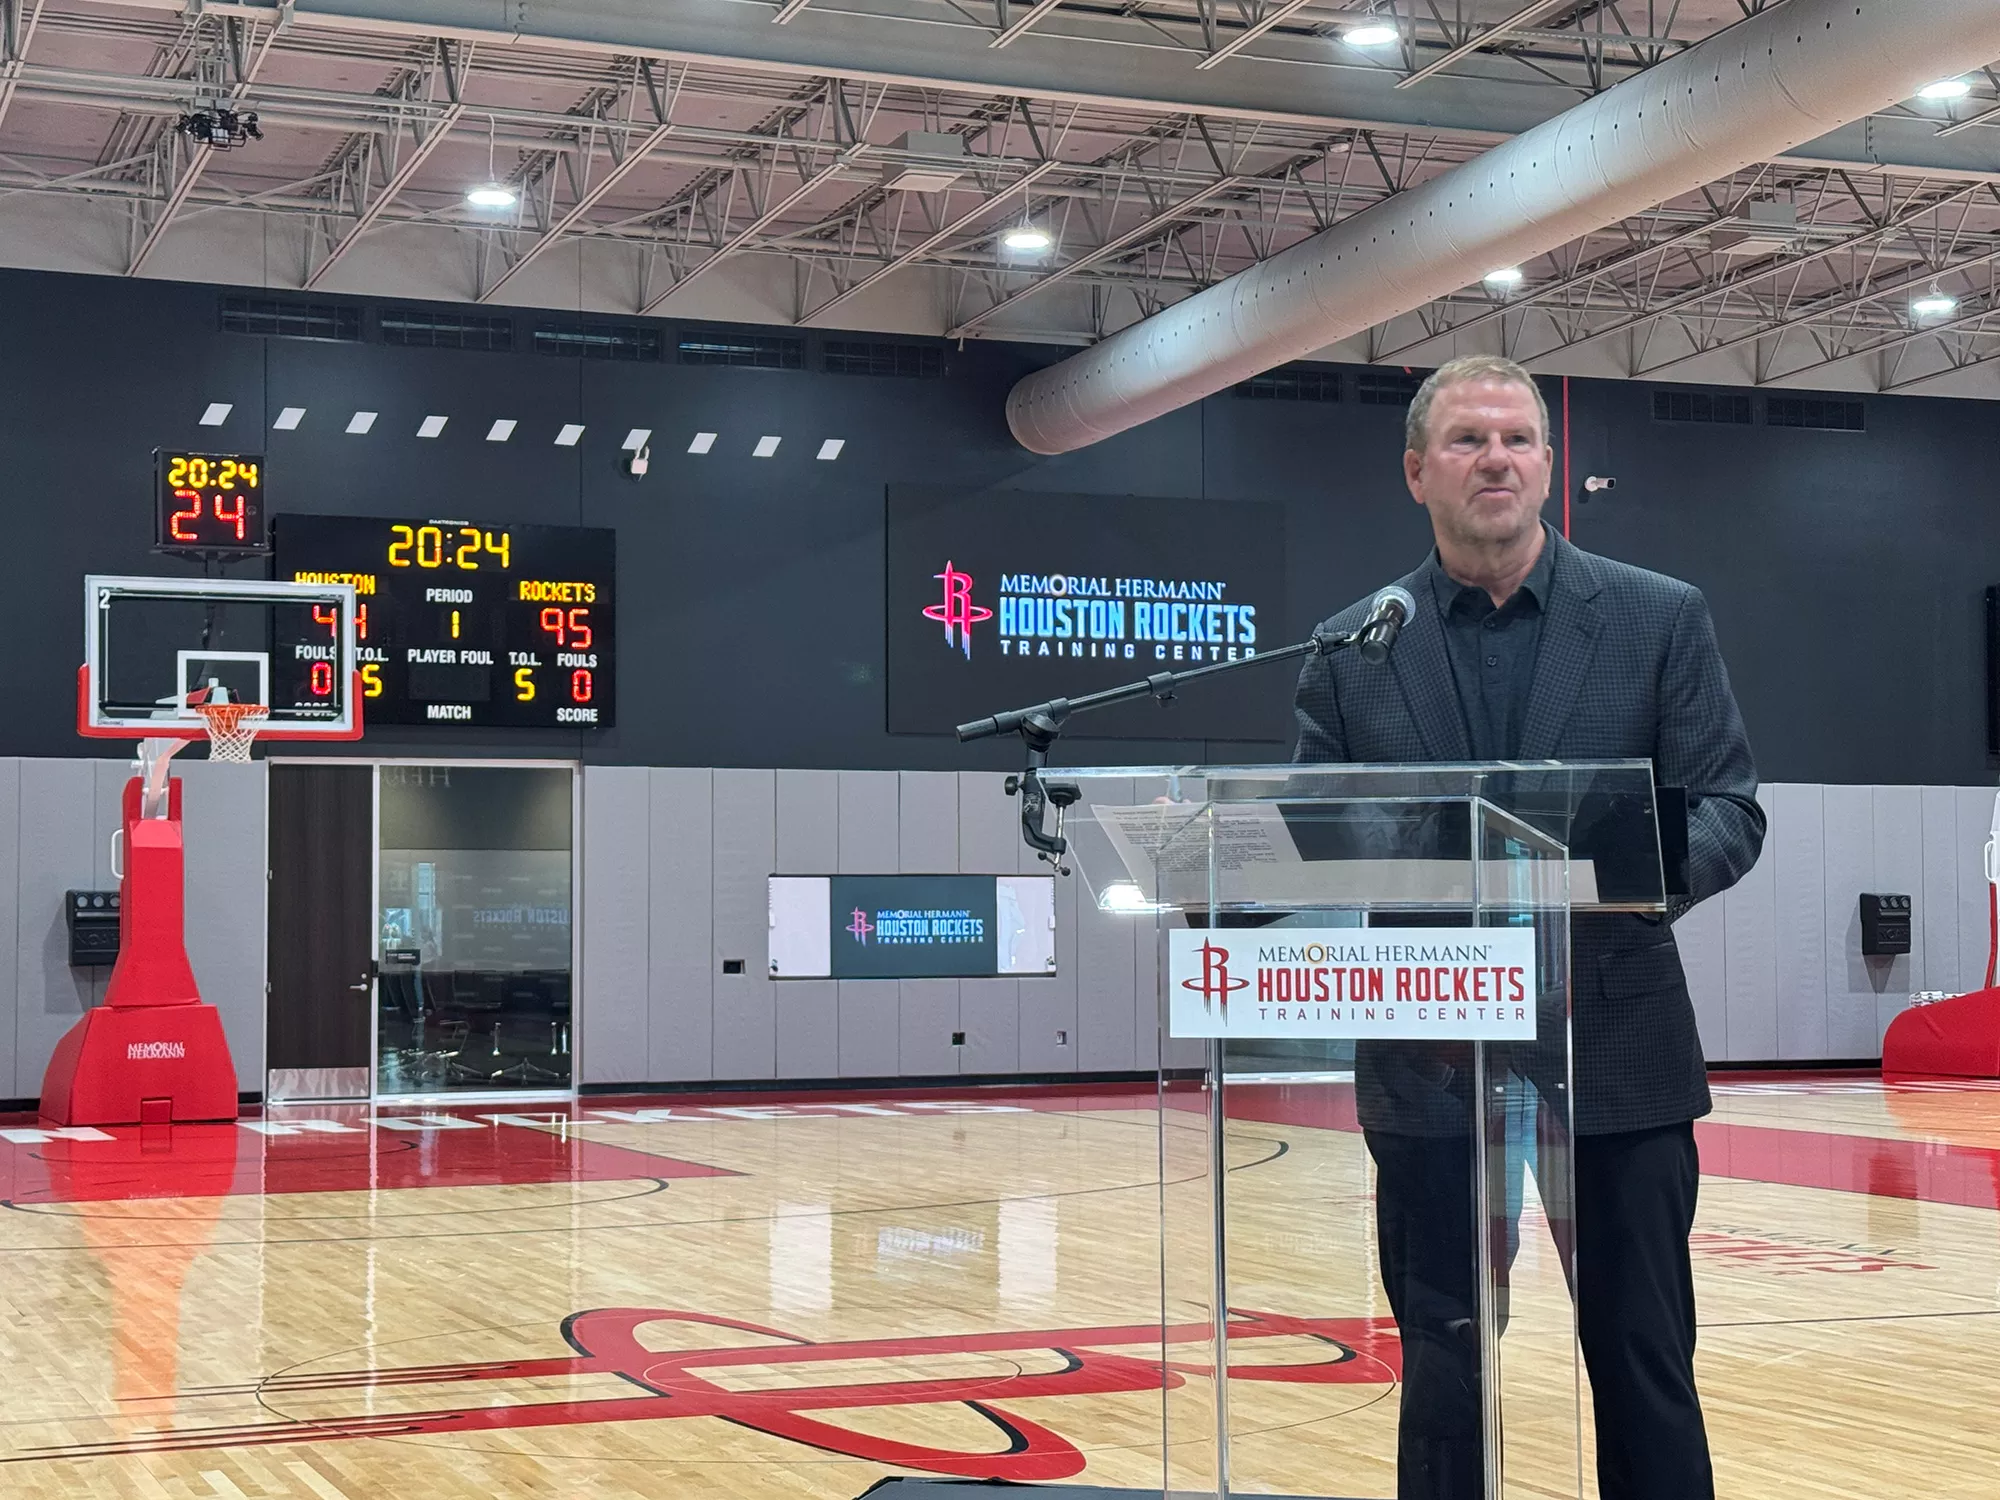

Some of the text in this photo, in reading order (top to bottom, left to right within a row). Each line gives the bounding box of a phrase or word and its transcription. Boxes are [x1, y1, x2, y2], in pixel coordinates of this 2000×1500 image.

[168, 457, 258, 490] 20:24
[170, 489, 245, 541] 24
[388, 525, 510, 570] 20:24
[426, 588, 473, 603] PERIOD
[519, 580, 596, 603] ROCKETS
[1000, 573, 1111, 597] MEMORIAL
[99, 588, 111, 610] 2
[452, 610, 460, 639] 1
[540, 607, 592, 649] 95
[1000, 597, 1256, 644] HOUSTON ROCKETS
[295, 645, 336, 660] FOULS
[408, 649, 494, 665] PLAYER FOUL
[509, 652, 542, 666] T.O.L.
[1001, 640, 1135, 658] TRAINING
[557, 653, 597, 667] FOULS
[311, 662, 332, 695] 0
[361, 664, 383, 697] 5
[514, 668, 535, 701] 5
[571, 669, 592, 702] 0
[427, 705, 471, 720] MATCH
[556, 708, 598, 722] SCORE
[877, 909, 923, 919] MEMORIAL
[876, 919, 984, 937] HOUSTON ROCKETS
[877, 936, 933, 944] TRAINING
[1258, 943, 1370, 963] MEMORIAL
[1258, 967, 1525, 1002] HOUSTON ROCKETS
[1259, 1008, 1525, 1020] TRAINING CENTER
[127, 1041, 186, 1051] MEMORIAL
[127, 1050, 186, 1059] HERMANN
[236, 1100, 1036, 1135] ROCKETS
